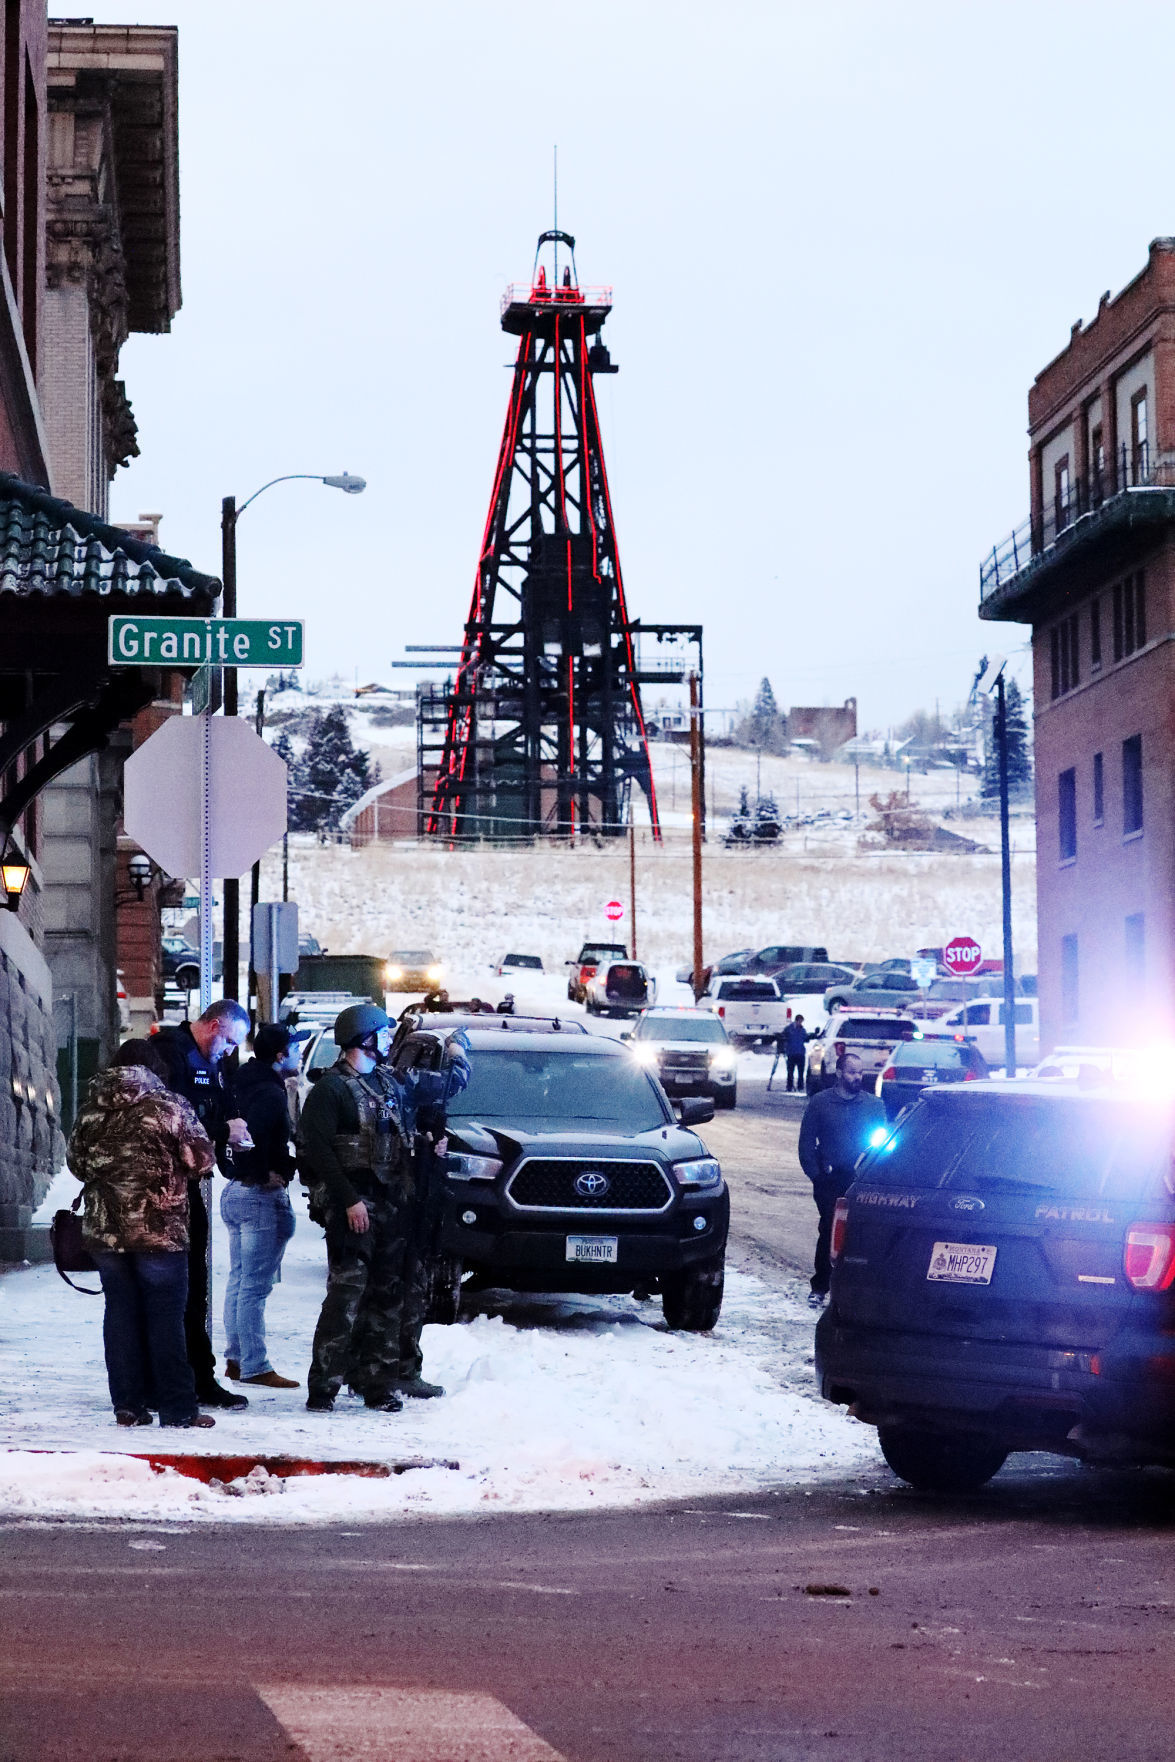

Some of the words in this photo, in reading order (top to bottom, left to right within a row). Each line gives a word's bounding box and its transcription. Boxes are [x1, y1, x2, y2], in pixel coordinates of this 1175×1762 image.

[118, 623, 250, 659] Granite
[267, 626, 297, 650] ST
[603, 905, 624, 917] STOP
[947, 946, 980, 962] STOP
[194, 1077, 210, 1085] POLICE
[856, 1191, 918, 1209] HIGHWAY
[1034, 1206, 1115, 1224] PATROL
[954, 1199, 975, 1211] Ford
[575, 1245, 613, 1257] BUKHNTR
[946, 1254, 989, 1274] MHP297
